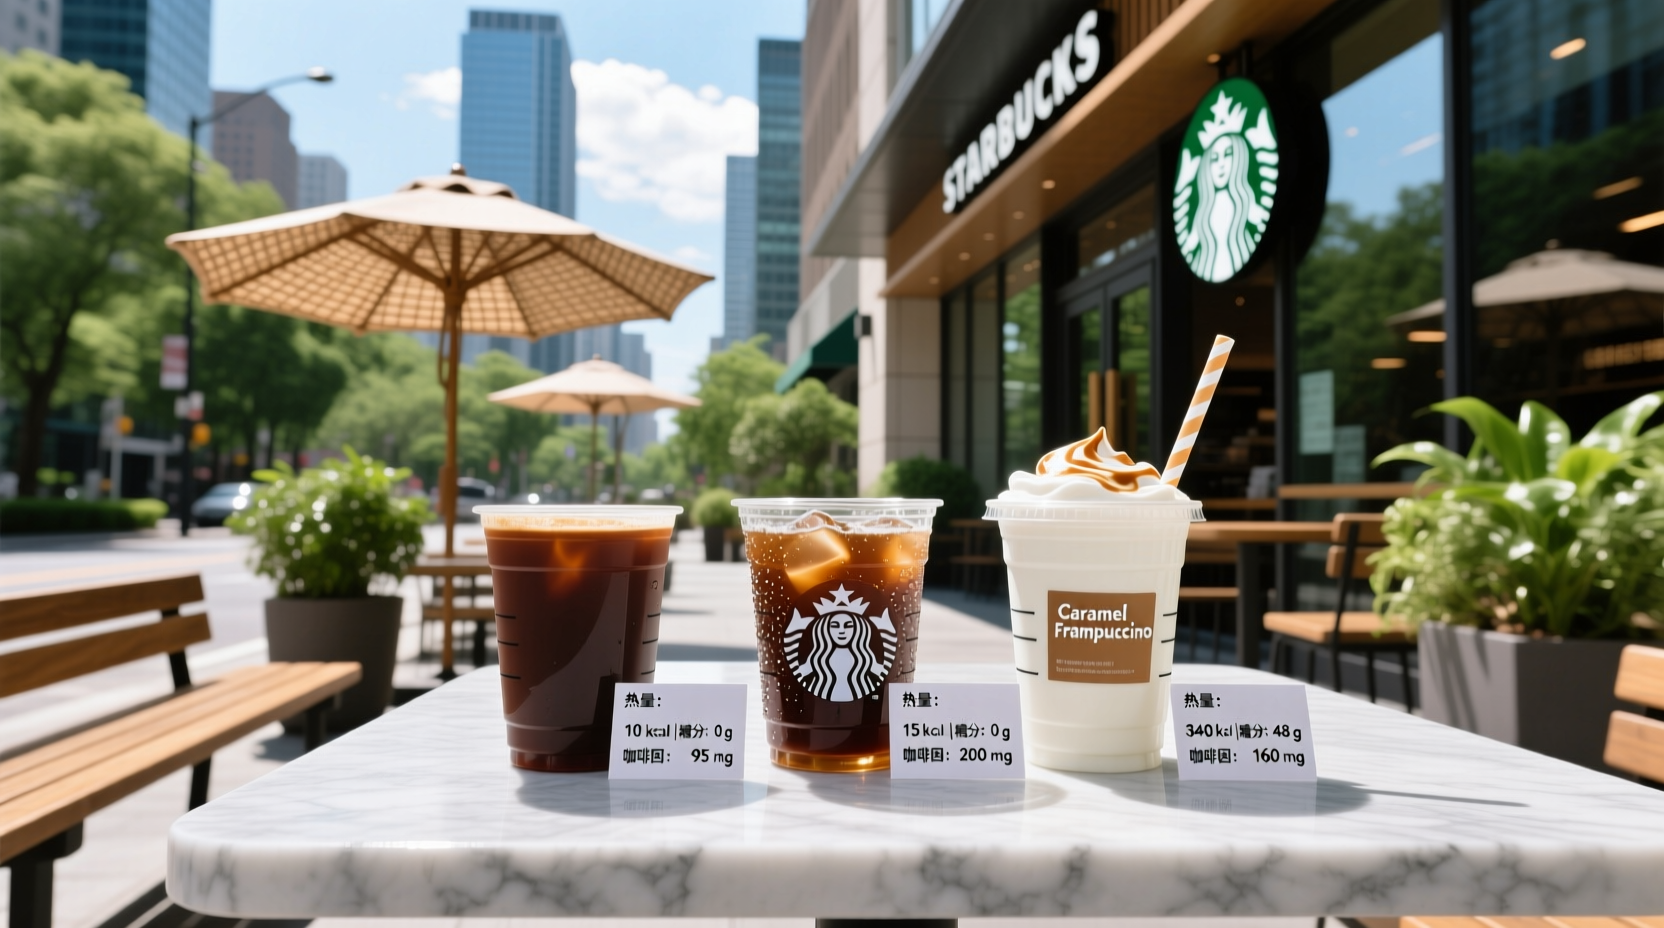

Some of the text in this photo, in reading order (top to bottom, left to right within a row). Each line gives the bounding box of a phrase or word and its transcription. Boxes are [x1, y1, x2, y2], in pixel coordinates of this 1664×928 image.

[942, 9, 1100, 214] STARBUCKS
[1057, 603, 1128, 621] Caramel
[1054, 621, 1153, 644] Frampuccino
[625, 723, 642, 738] 10
[903, 722, 920, 737] 15
[1185, 723, 1213, 738] 340
[690, 748, 710, 763] 95
[713, 753, 734, 767] mg
[959, 747, 987, 762] 200
[990, 751, 1013, 766] mg
[1252, 748, 1280, 763] 160
[1283, 752, 1306, 767] mg
